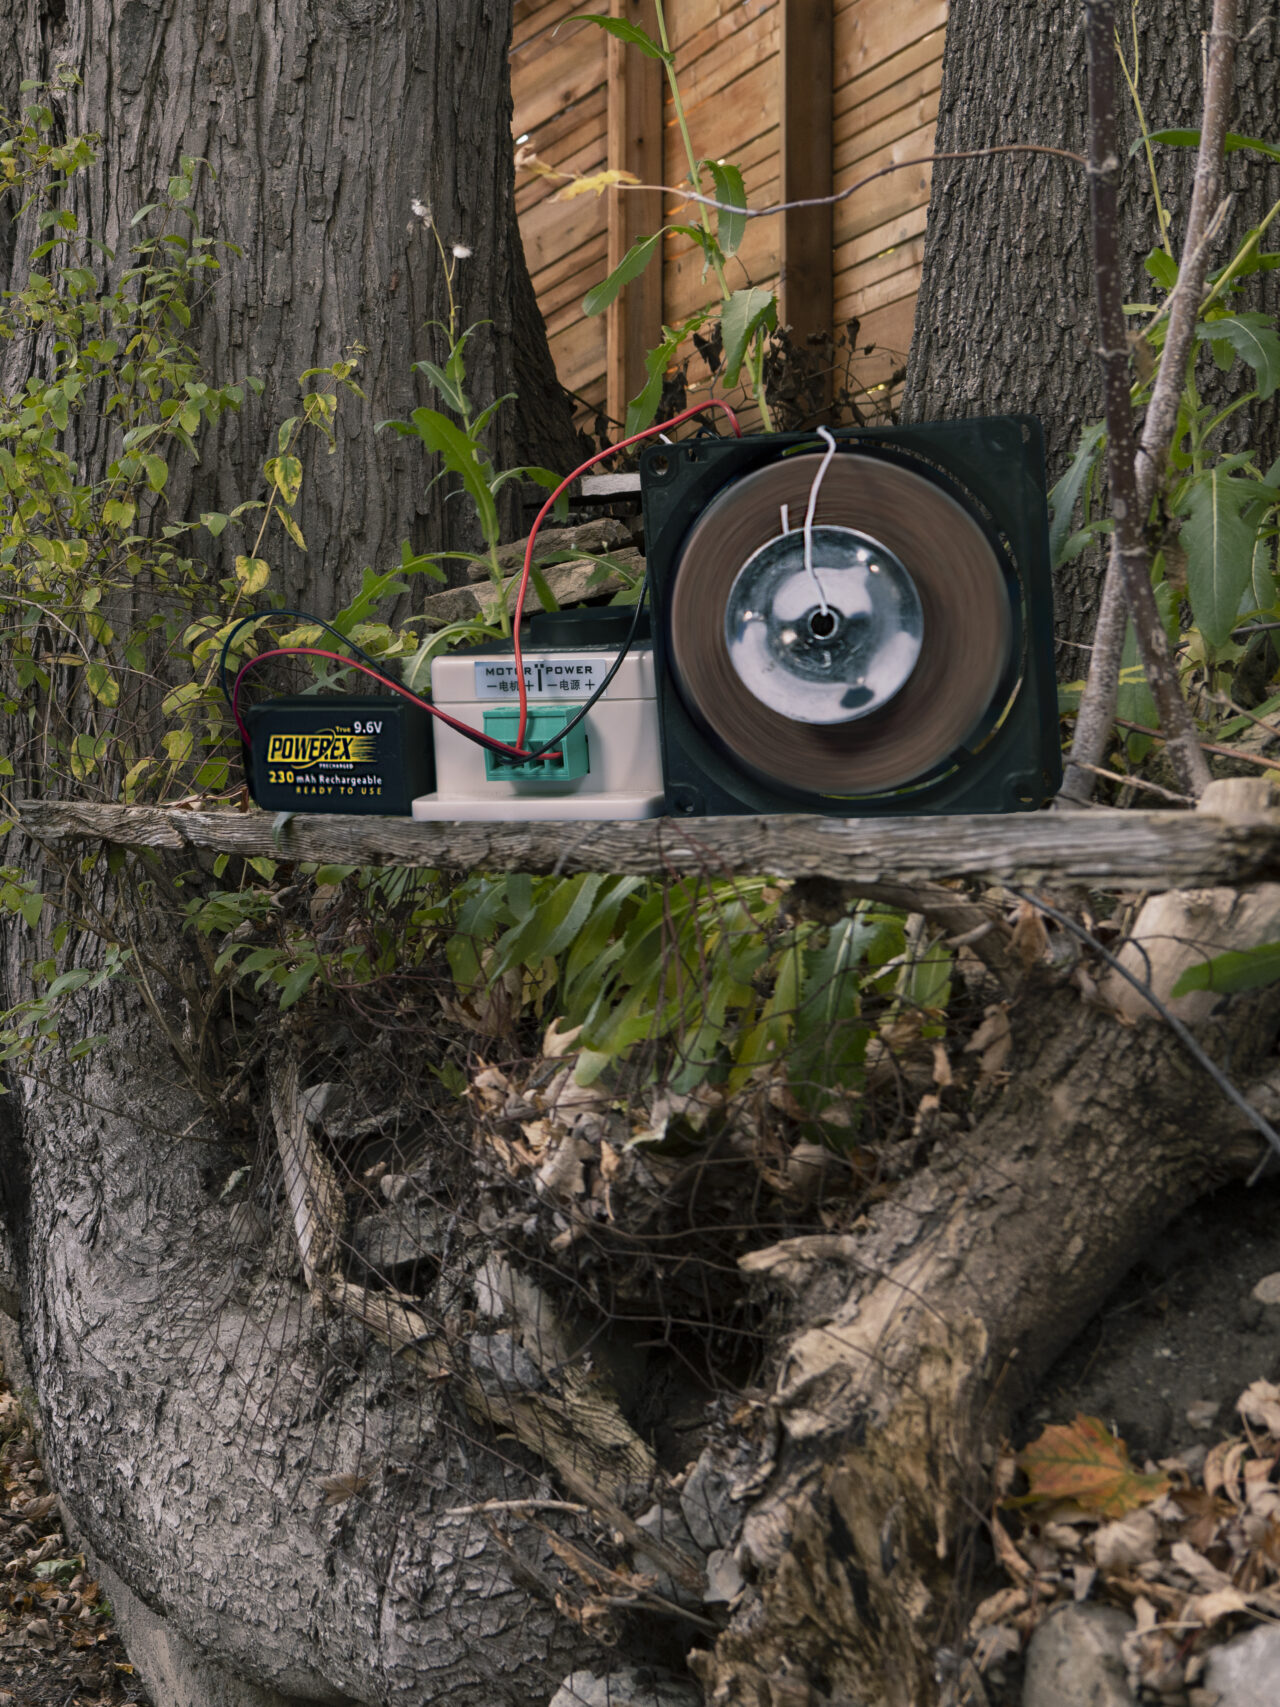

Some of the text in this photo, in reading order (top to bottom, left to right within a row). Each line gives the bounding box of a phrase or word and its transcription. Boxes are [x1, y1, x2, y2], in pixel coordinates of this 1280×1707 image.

[546, 666, 593, 675] POWER
[559, 680, 580, 691] 电源
[354, 721, 383, 734] 9.6V
[270, 737, 353, 760] POWEREX
[268, 771, 382, 786] 230 mAh Rechargeable
[296, 786, 382, 795] READY TO USE
